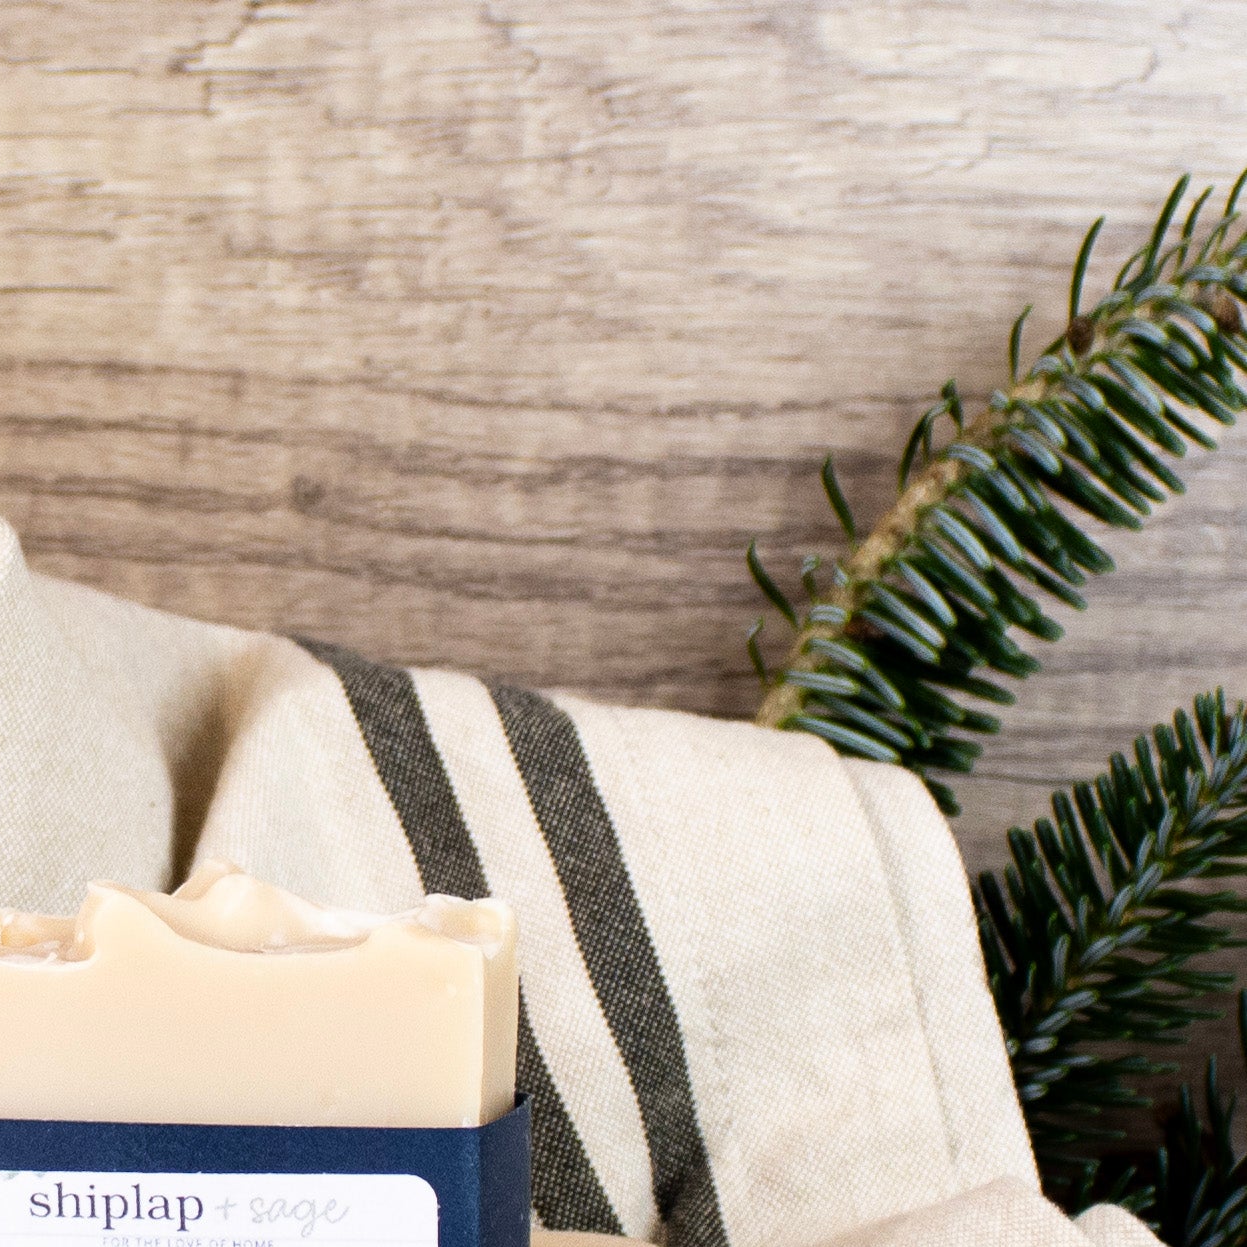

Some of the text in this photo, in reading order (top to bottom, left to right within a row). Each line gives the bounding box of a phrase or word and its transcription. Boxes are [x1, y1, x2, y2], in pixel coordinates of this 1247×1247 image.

[29, 1182, 350, 1238] shiplap + sage
[102, 1237, 130, 1247] FOR
[134, 1237, 162, 1247] THE
